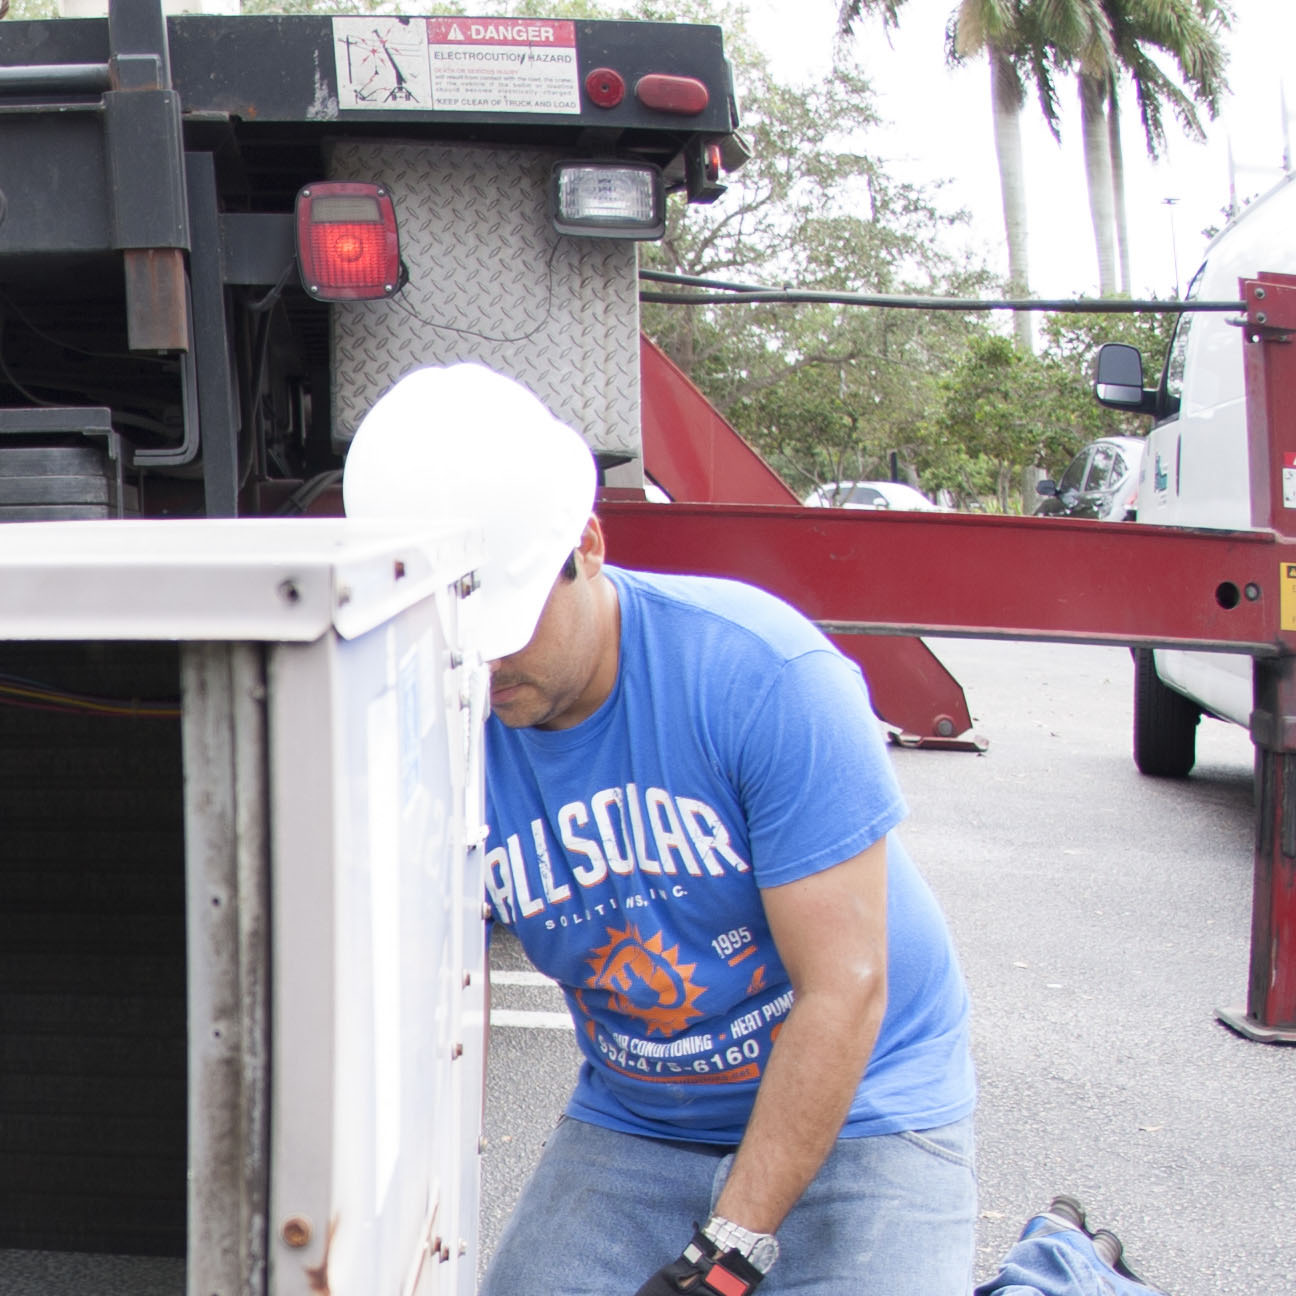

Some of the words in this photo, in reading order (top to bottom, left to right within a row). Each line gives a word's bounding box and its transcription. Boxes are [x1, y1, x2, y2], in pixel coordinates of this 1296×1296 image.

[471, 25, 554, 42] DANGER
[434, 51, 524, 62] ELECTROCUTION
[528, 53, 572, 63] HAZARD
[711, 926, 752, 959] 1995
[630, 1034, 713, 1058] CONDITIONING
[730, 1009, 763, 1039] HEAT
